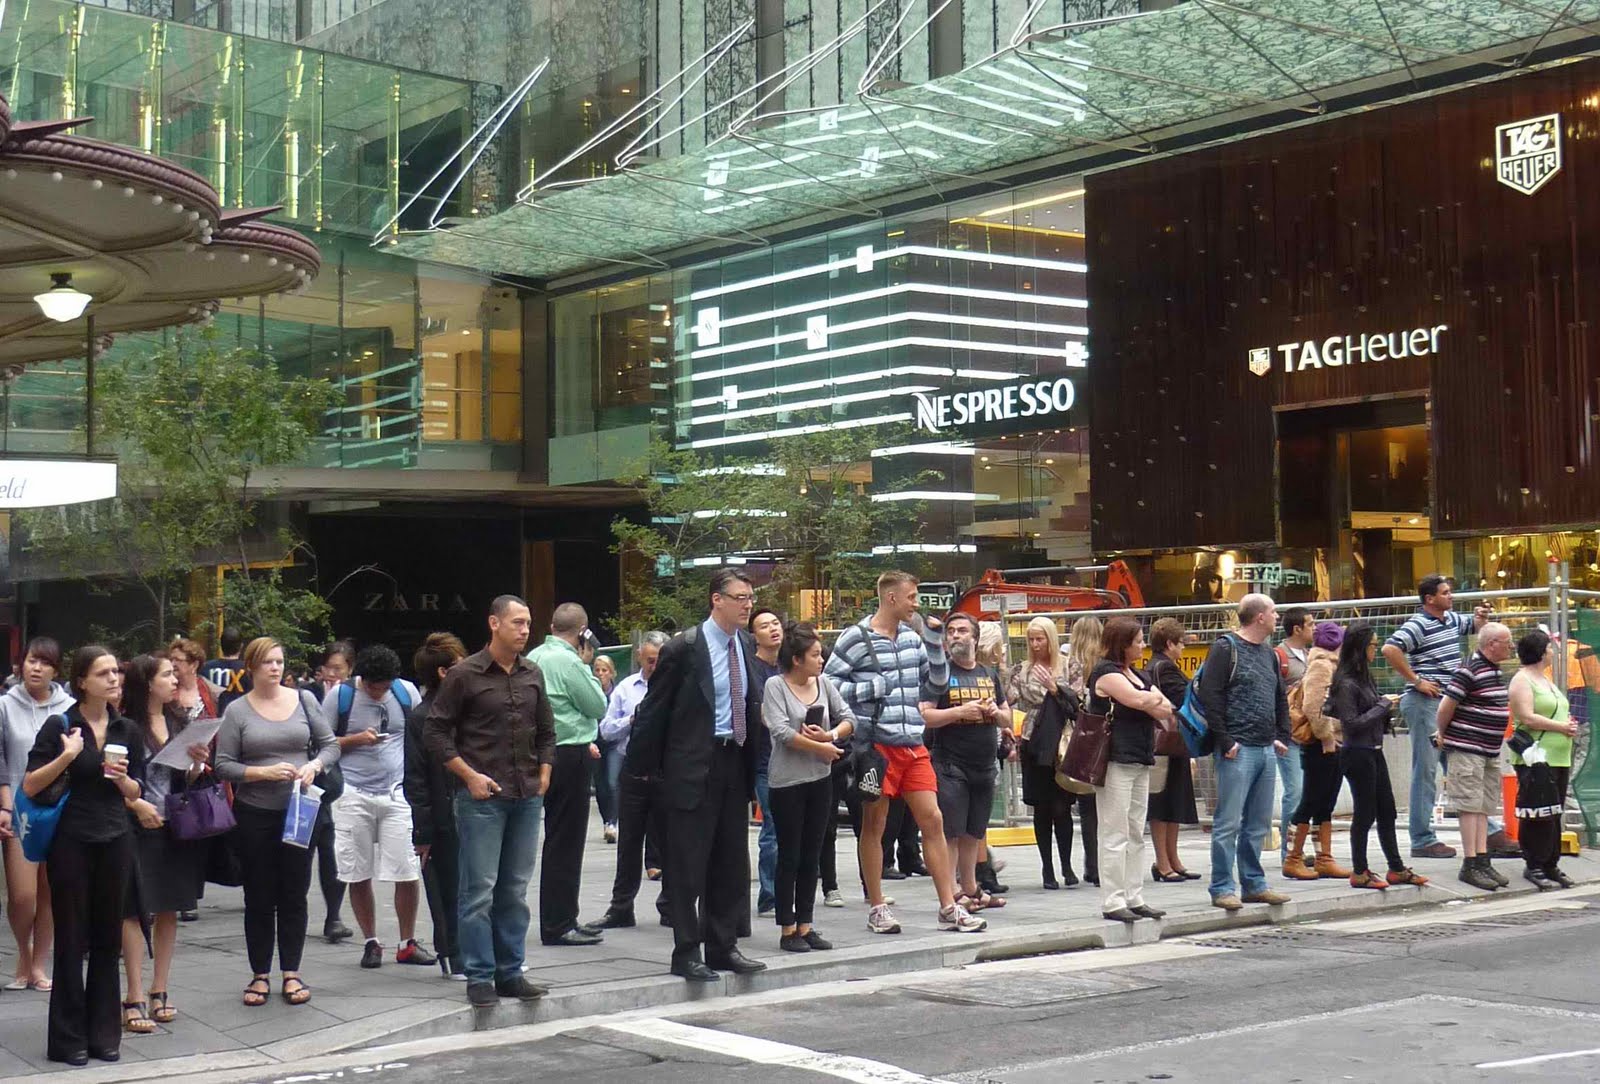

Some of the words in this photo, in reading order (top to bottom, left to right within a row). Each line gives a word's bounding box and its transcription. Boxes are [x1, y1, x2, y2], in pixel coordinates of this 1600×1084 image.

[1506, 122, 1549, 156] TAG
[1502, 152, 1556, 189] HEUER
[911, 378, 1075, 434] NESPRESSO
[363, 592, 471, 611] ZARA
[1028, 595, 1072, 606] KUBOTA
[209, 667, 245, 692] mx
